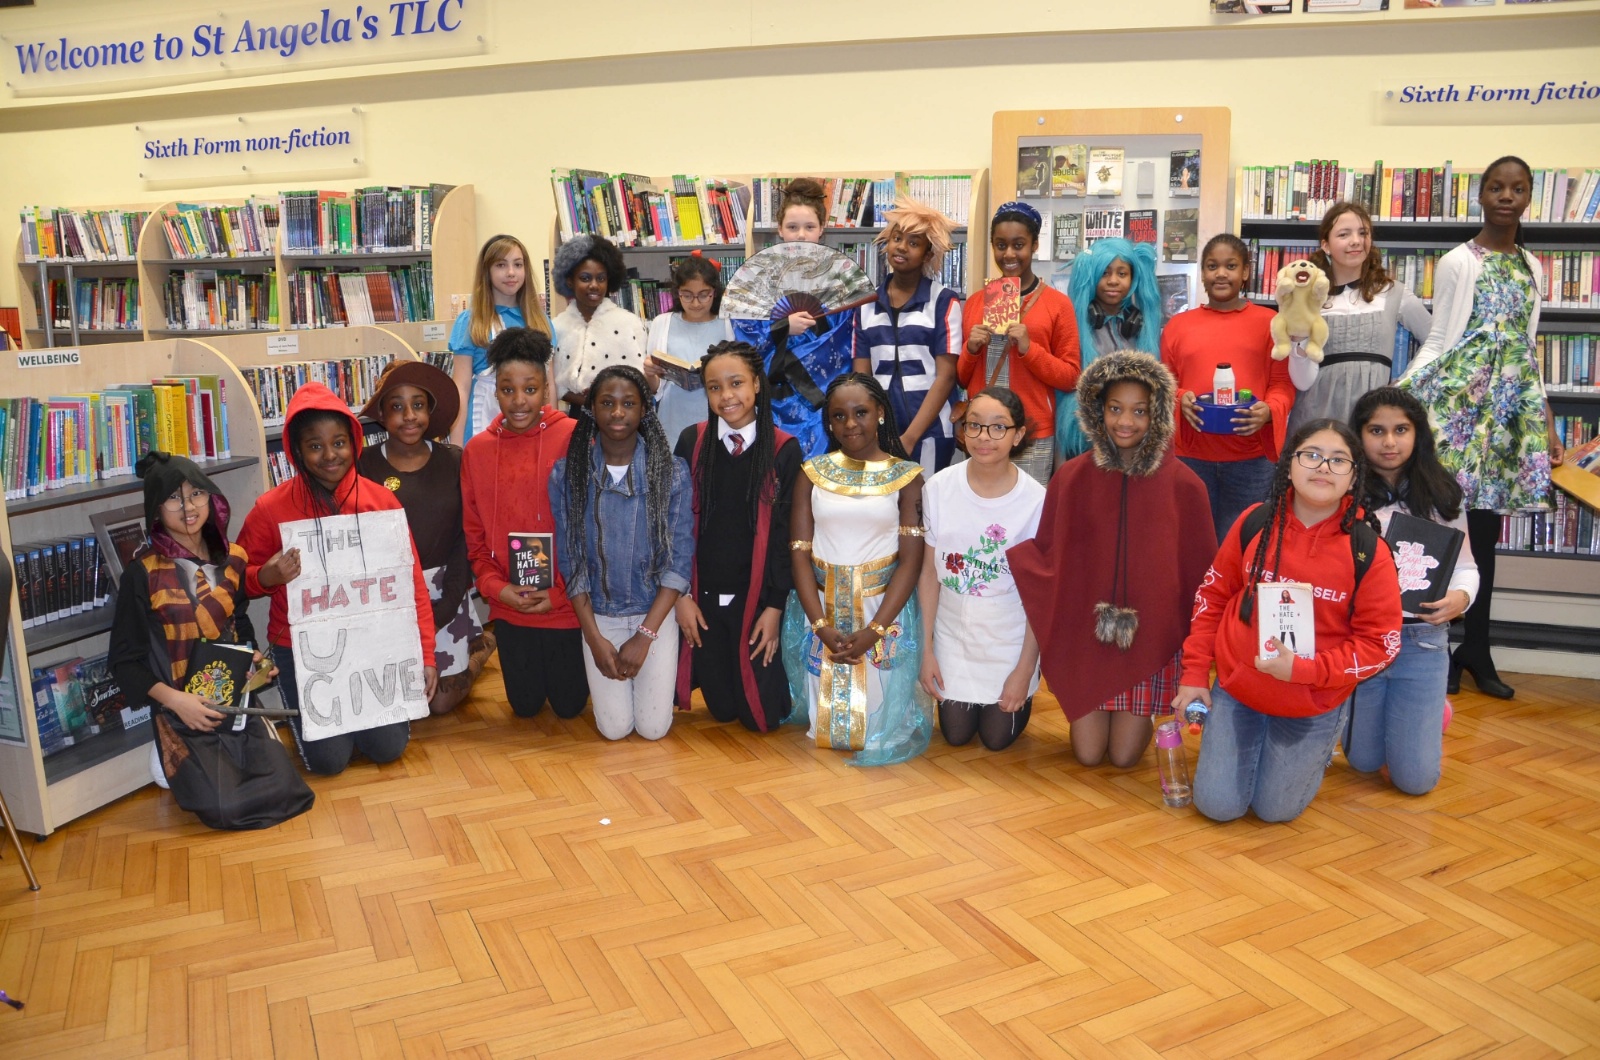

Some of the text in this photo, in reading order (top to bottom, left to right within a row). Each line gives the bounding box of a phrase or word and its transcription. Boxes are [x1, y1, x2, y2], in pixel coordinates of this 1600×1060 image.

[15, 0, 465, 74] Welcome to St Angela's TLC
[1400, 84, 1459, 103] Sixth
[1465, 84, 1530, 102] Form
[144, 128, 351, 160] Sixth Form non-fiction
[1129, 219, 1153, 231] HOUSE
[1134, 230, 1157, 242] CARDS
[18, 352, 79, 367] WELLBEING
[298, 530, 362, 553] THE
[515, 550, 533, 560] THE
[517, 558, 539, 569] HATE
[519, 570, 524, 578] U
[520, 575, 540, 586] GIVE
[301, 575, 397, 617] HATE
[1279, 576, 1347, 602] YOSELF
[299, 629, 347, 673] U
[91, 684, 120, 707] Sawbon
[303, 658, 423, 726] GIVE
